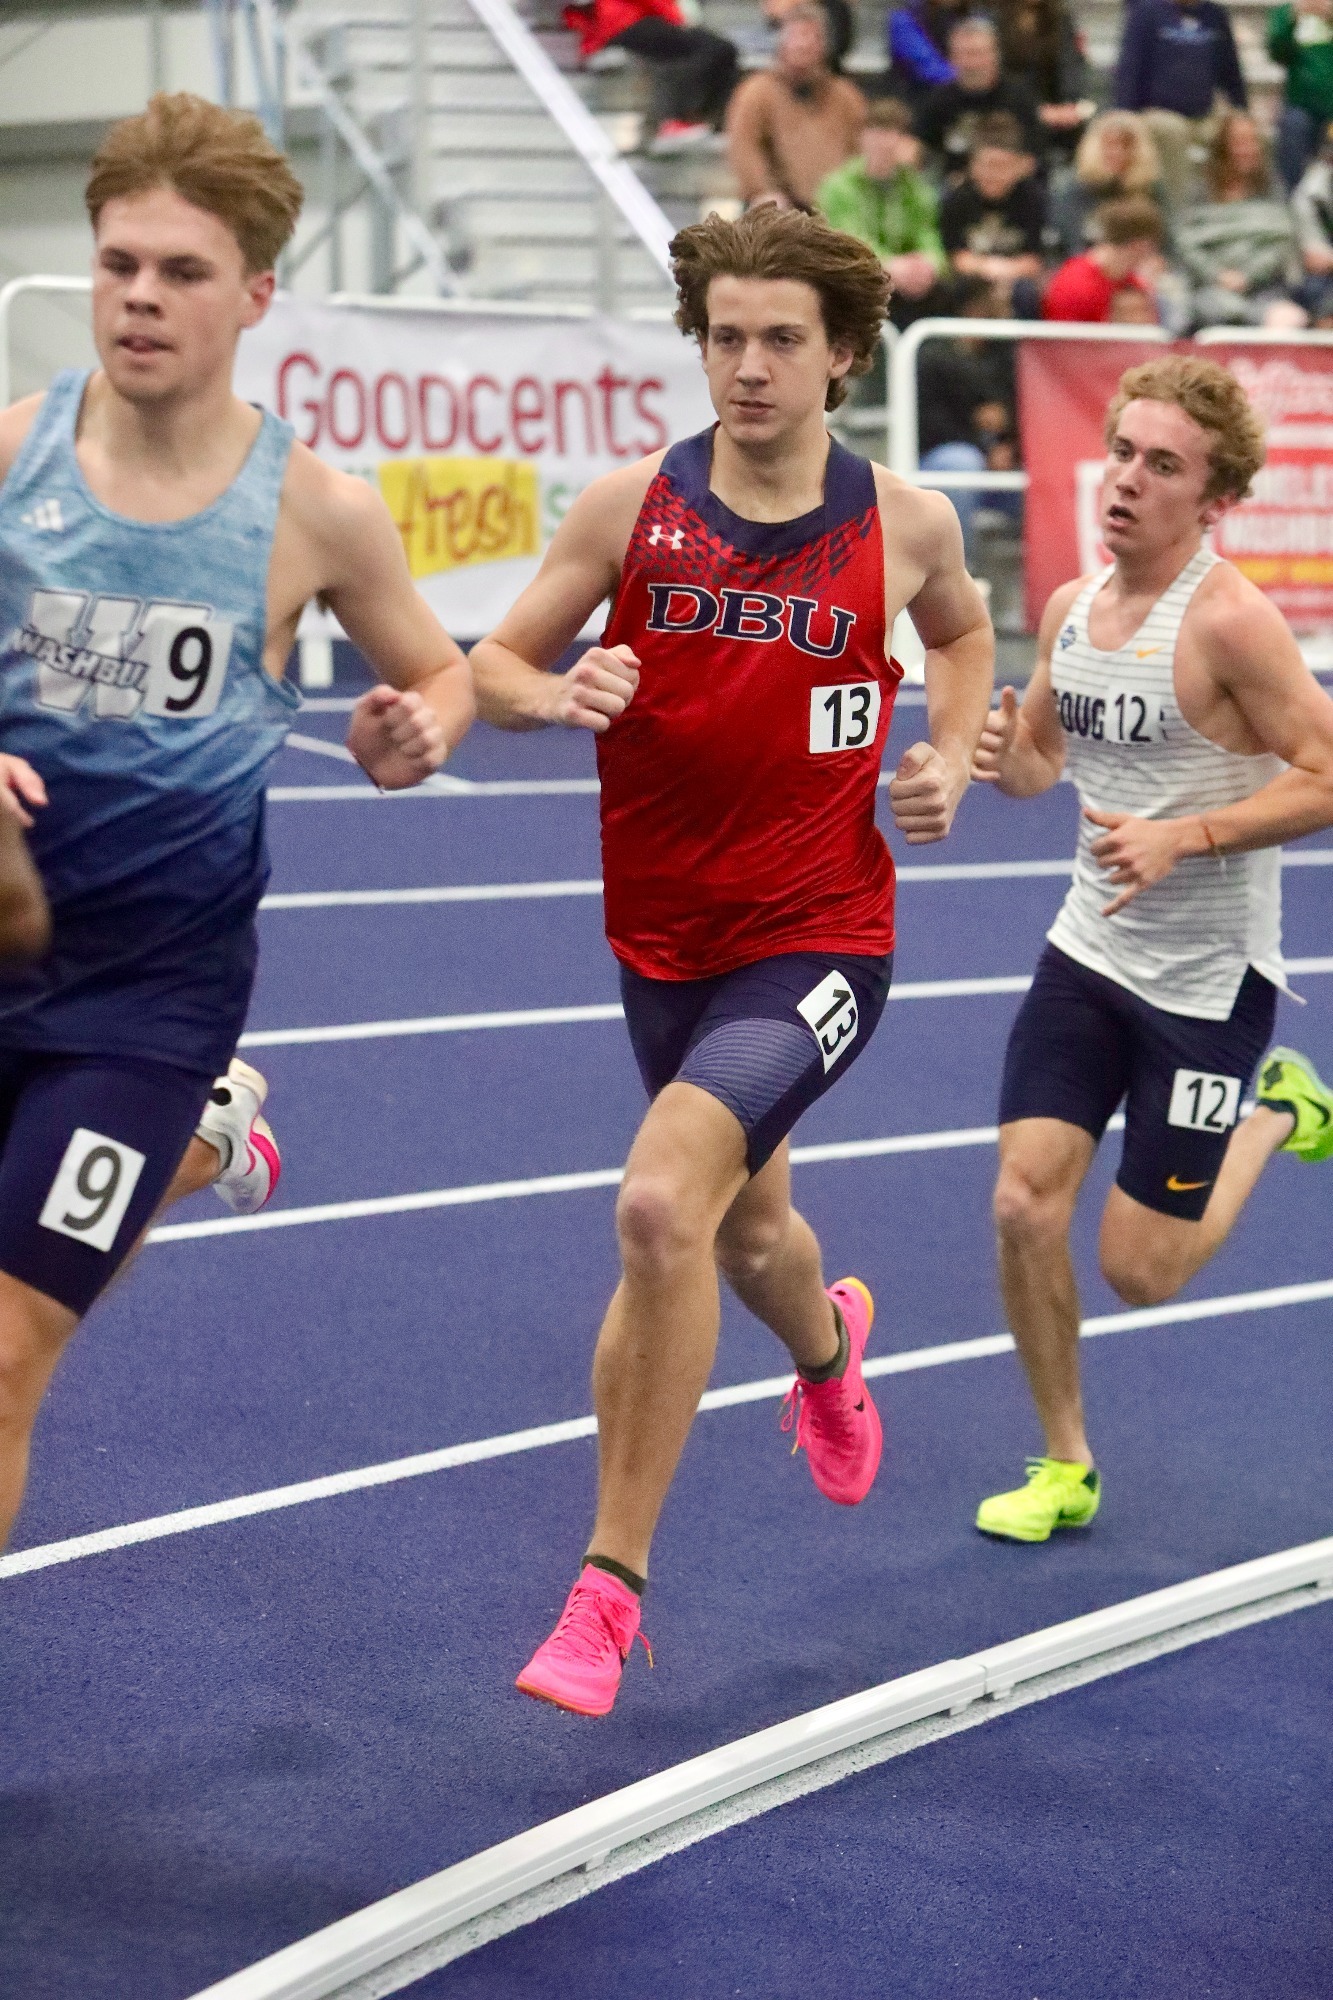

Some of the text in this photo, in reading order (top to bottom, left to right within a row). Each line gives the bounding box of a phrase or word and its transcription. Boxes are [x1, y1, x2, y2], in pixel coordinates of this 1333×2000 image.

[397, 461, 537, 562] fresh
[646, 583, 857, 659] DBU
[14, 624, 149, 692] WASHBU
[164, 626, 213, 712] 9
[823, 685, 872, 748] 13
[1052, 688, 1106, 741] OUG
[1115, 693, 1152, 742] 12
[814, 988, 857, 1056] 13
[1187, 1077, 1227, 1128] 12
[61, 1145, 121, 1231] 9
